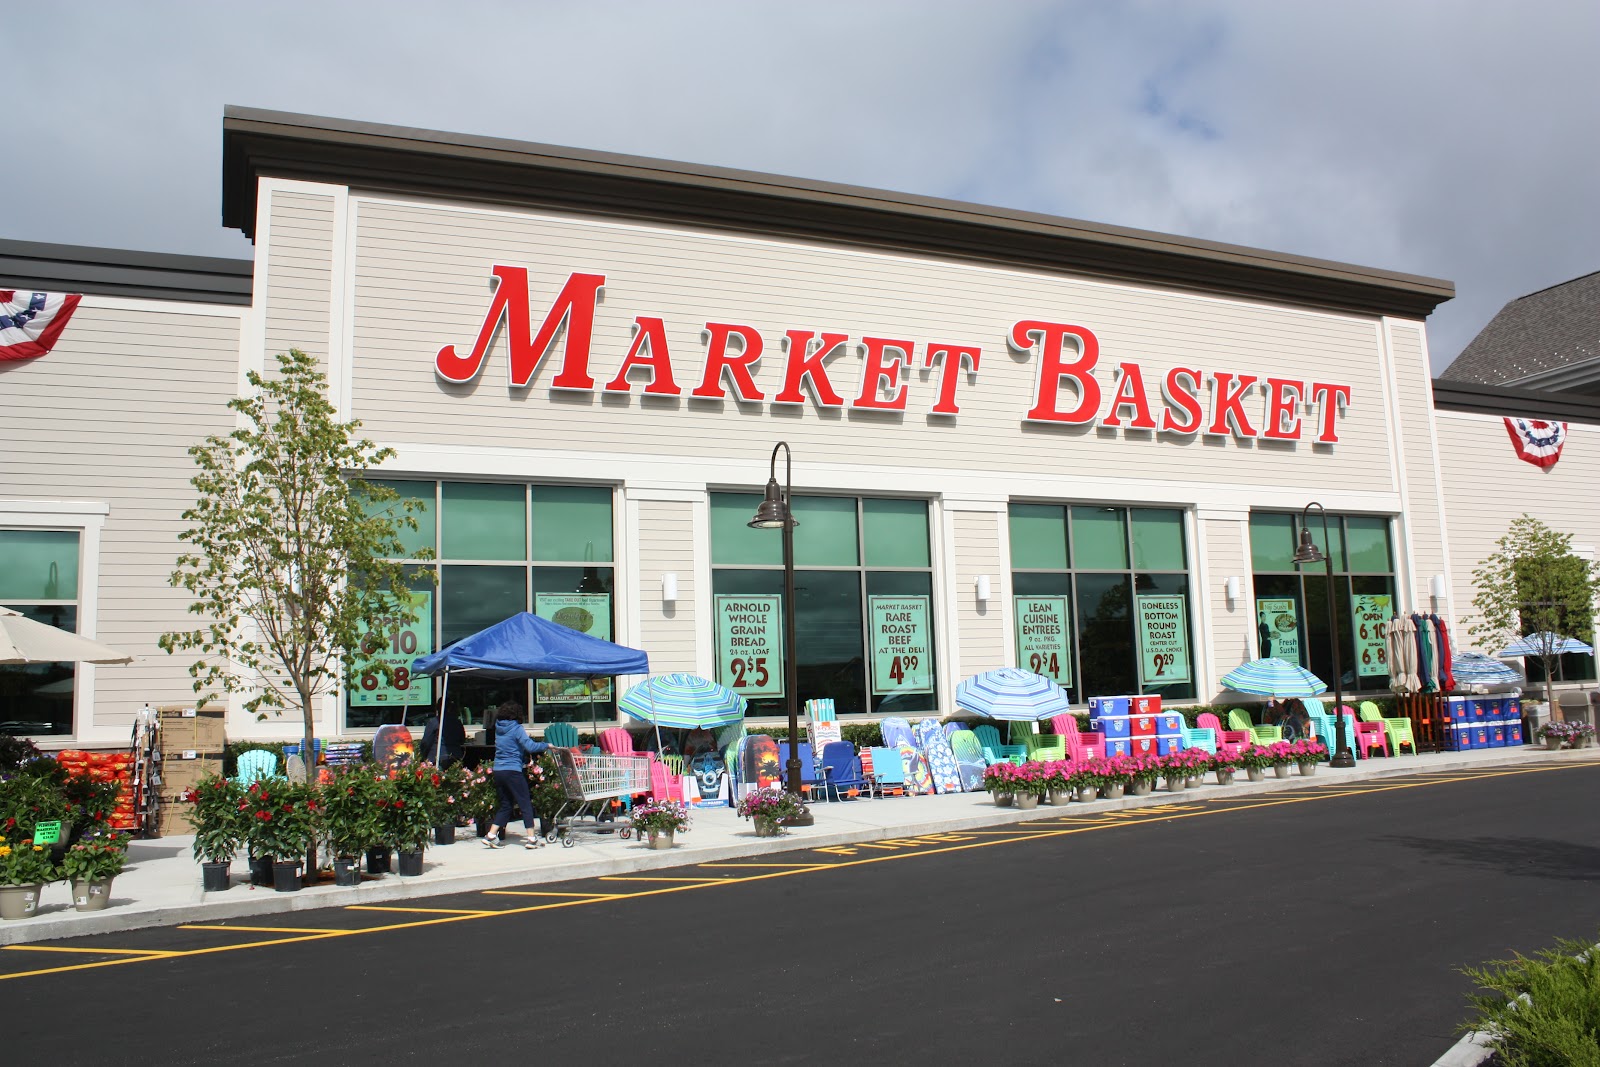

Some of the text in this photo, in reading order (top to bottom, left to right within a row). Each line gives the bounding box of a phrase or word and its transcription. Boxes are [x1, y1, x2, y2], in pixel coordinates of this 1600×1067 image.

[435, 265, 1351, 443] MARKET BASKET
[724, 603, 770, 612] ARNOLD
[1028, 603, 1052, 612] LEAN
[728, 614, 767, 624] WHOLE
[886, 612, 912, 622] RARE
[1024, 614, 1058, 624] CUISINE
[730, 626, 766, 634] GRAIN
[882, 624, 917, 634] ROAST
[1022, 625, 1060, 634] ENTREES
[731, 637, 766, 646] BREAD
[888, 636, 912, 645] BEEF
[812, 804, 1207, 855] FIRE LANE
